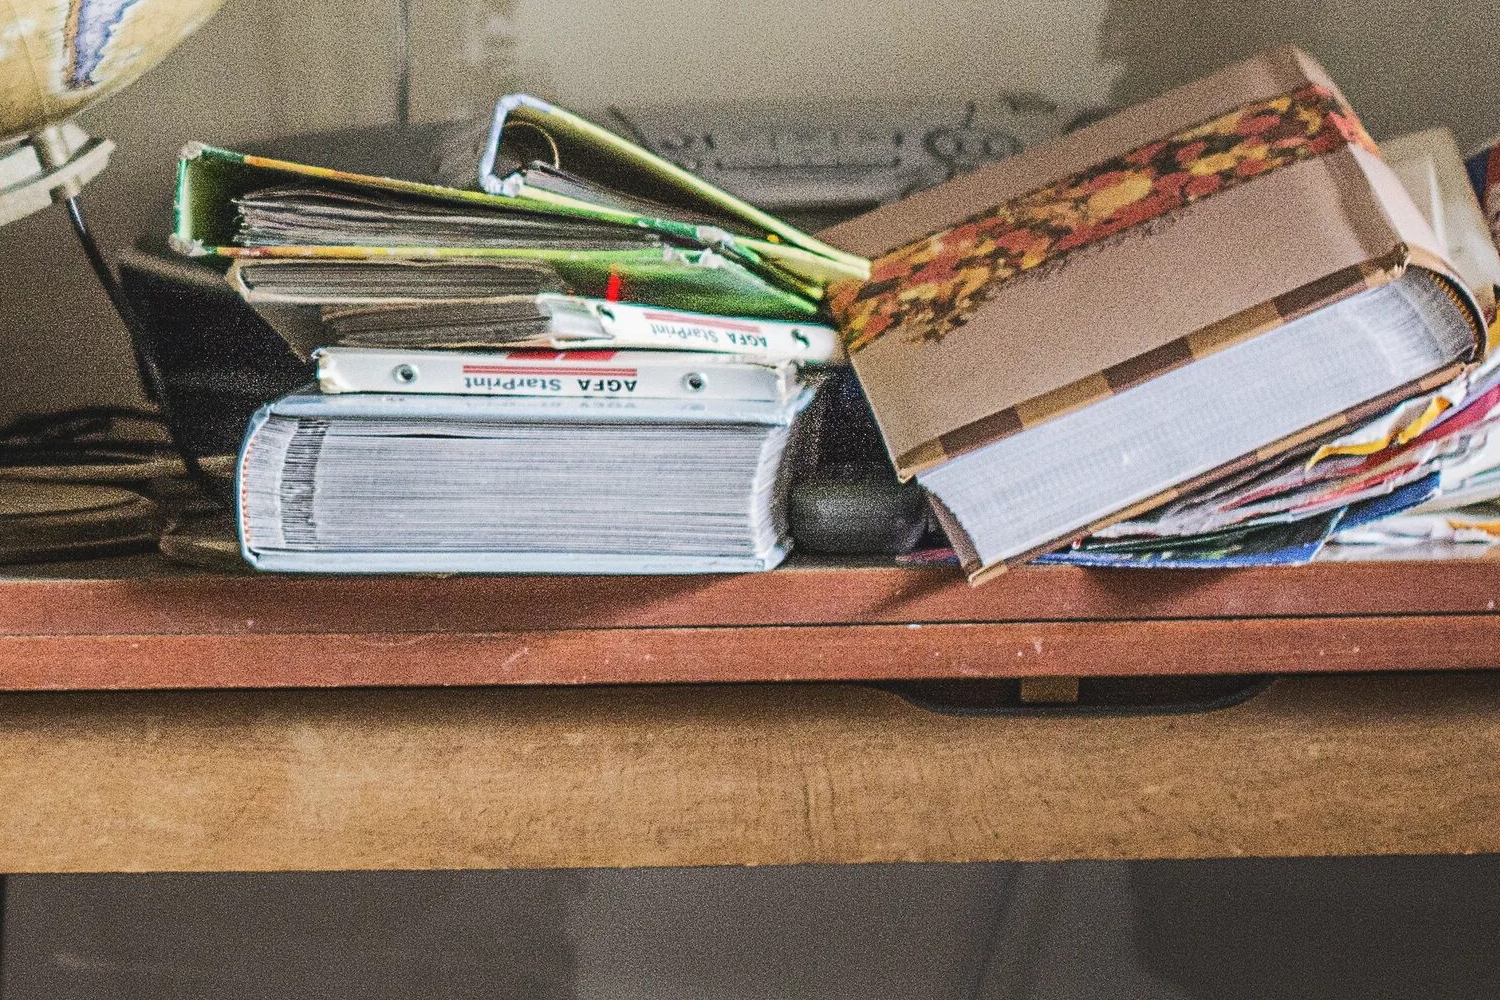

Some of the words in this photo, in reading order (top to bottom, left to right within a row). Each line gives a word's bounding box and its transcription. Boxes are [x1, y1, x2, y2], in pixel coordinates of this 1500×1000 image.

[649, 323, 719, 343] StarPrint
[726, 331, 768, 348] AGFA
[464, 376, 562, 392] StarPrint
[577, 378, 638, 393] AGFA
